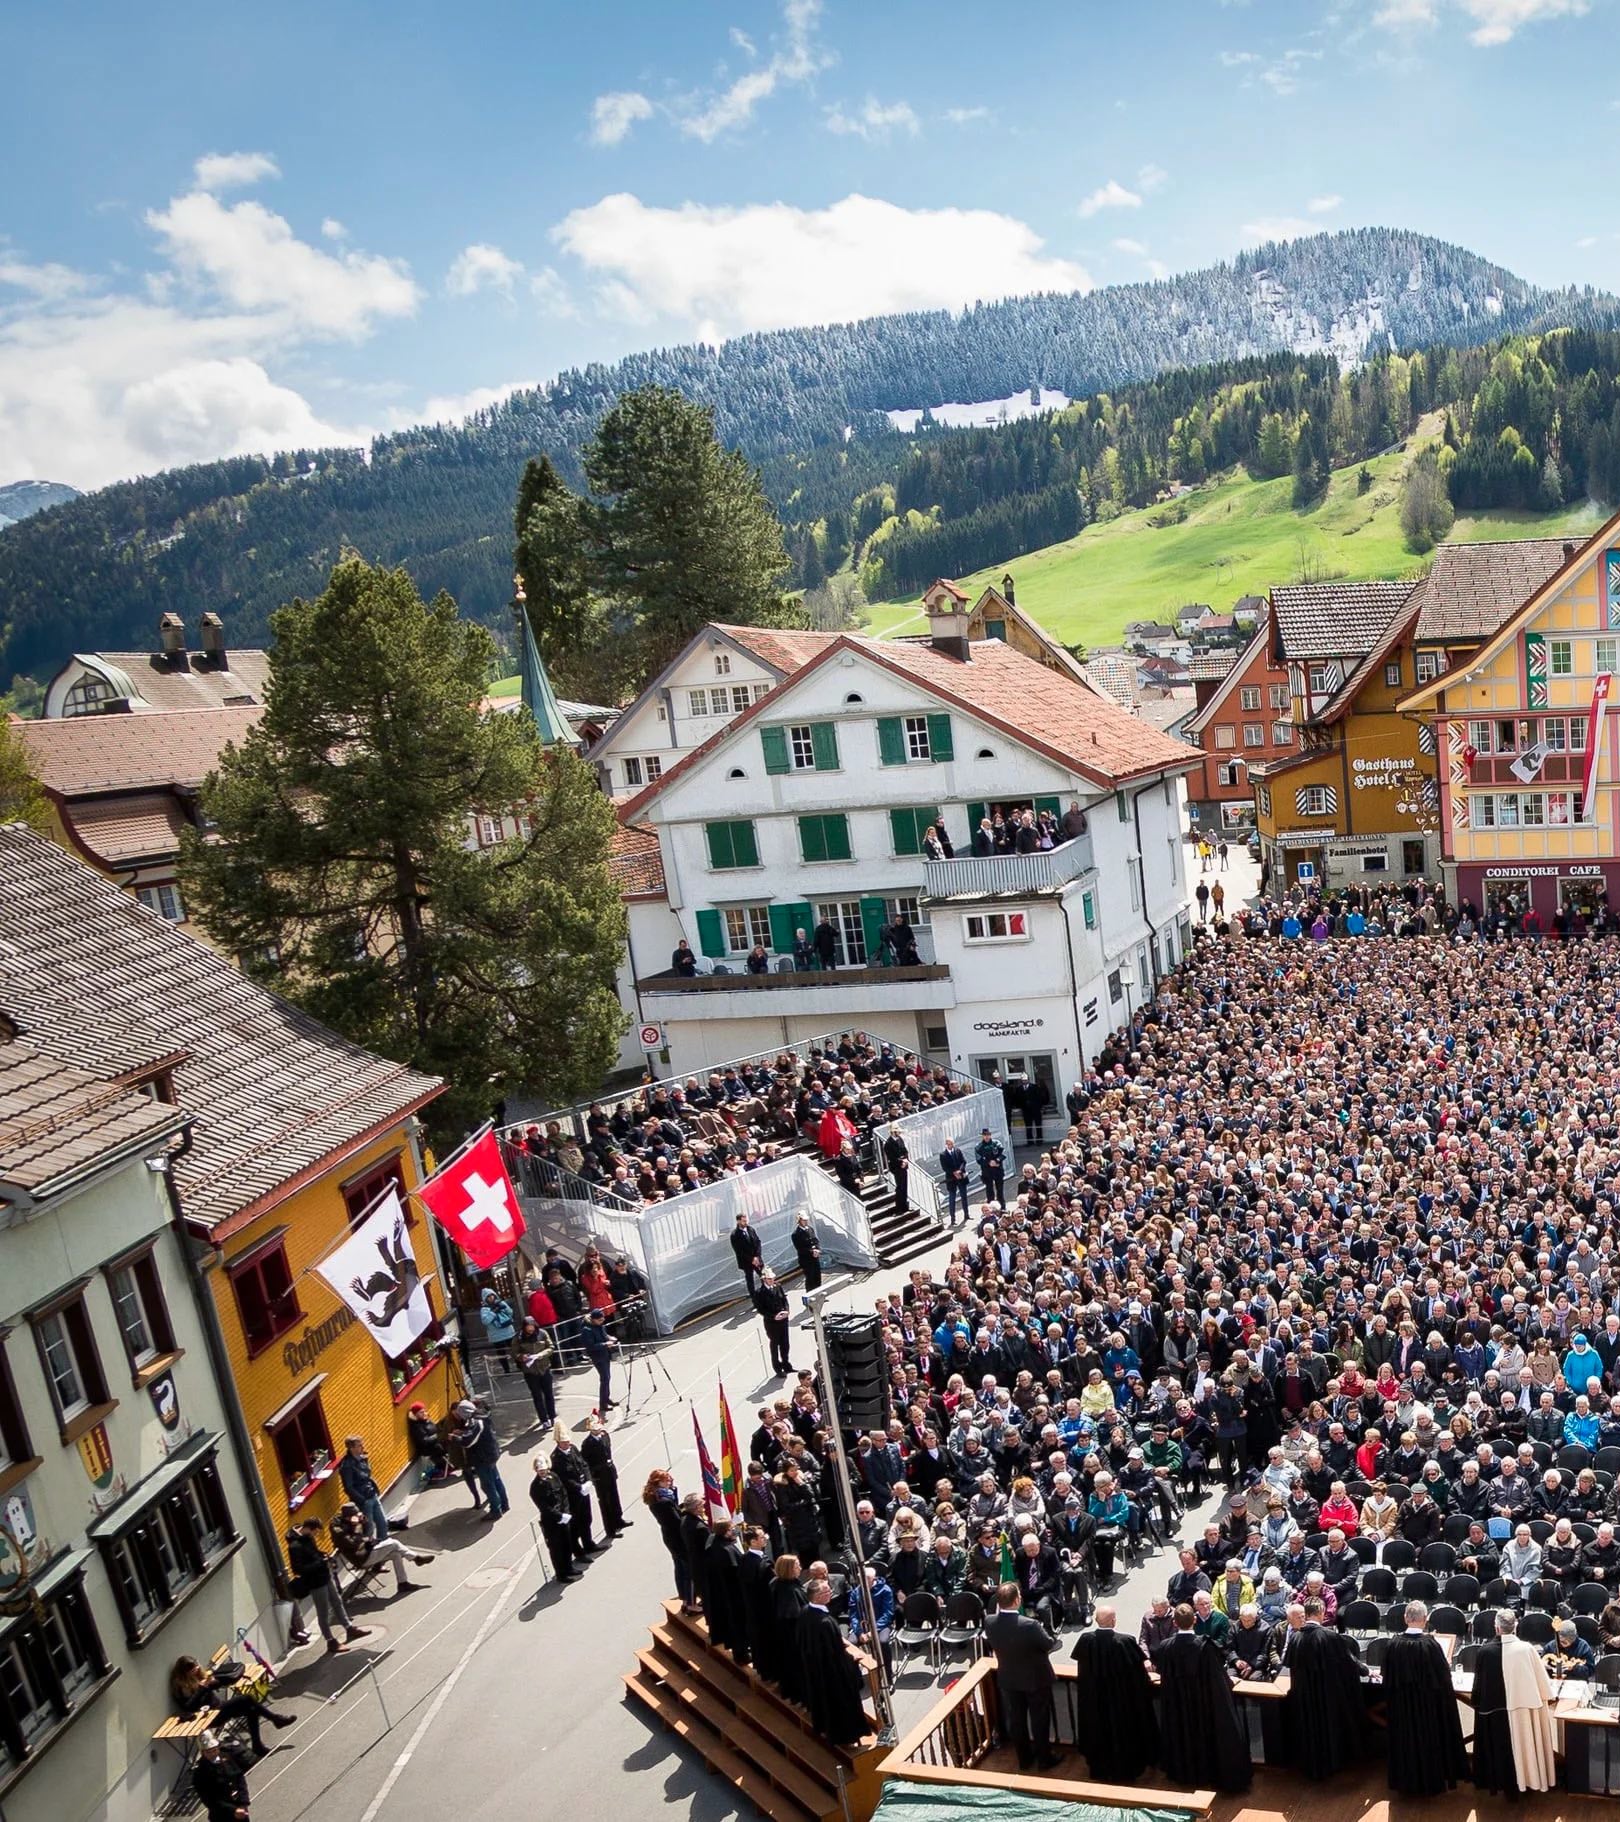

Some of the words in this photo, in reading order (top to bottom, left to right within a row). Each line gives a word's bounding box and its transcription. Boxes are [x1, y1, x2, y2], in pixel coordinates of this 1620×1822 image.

[1352, 757, 1415, 773] Gasthaus
[1353, 771, 1391, 790] Hotel
[1328, 845, 1388, 857] Familienhotel
[1486, 866, 1559, 877] CONDITOREI
[1569, 865, 1600, 875] CAFE
[988, 1029, 1031, 1038] MANUFAKTUR
